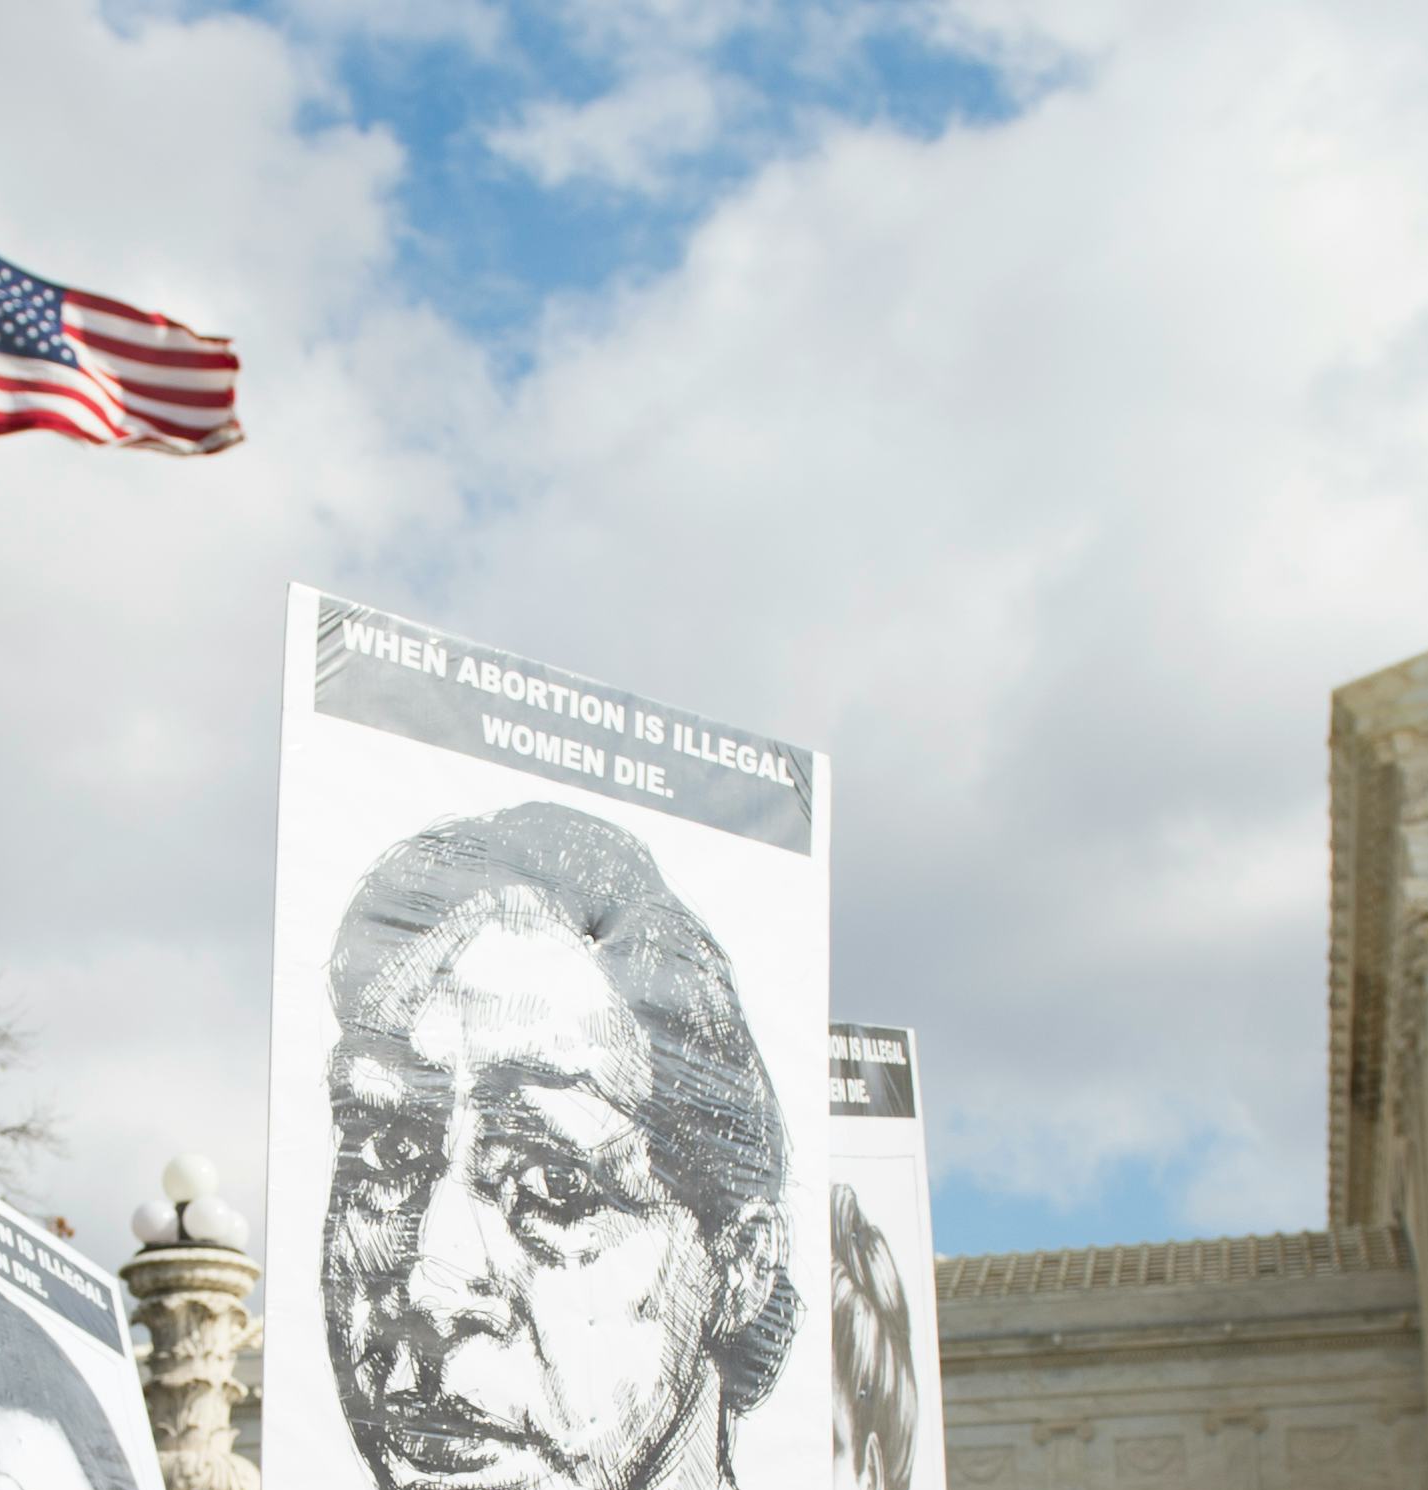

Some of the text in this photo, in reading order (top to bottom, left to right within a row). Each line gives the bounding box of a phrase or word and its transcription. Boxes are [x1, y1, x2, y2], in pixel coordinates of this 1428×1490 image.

[341, 619, 795, 788] WHEN ABORTION IS ILLEGAL
[482, 714, 674, 798] WOMEN DIE.
[848, 1036, 862, 1062] IS
[828, 1077, 847, 1103] EN
[17, 1234, 35, 1261] IS
[13, 1260, 49, 1299] DIE.
